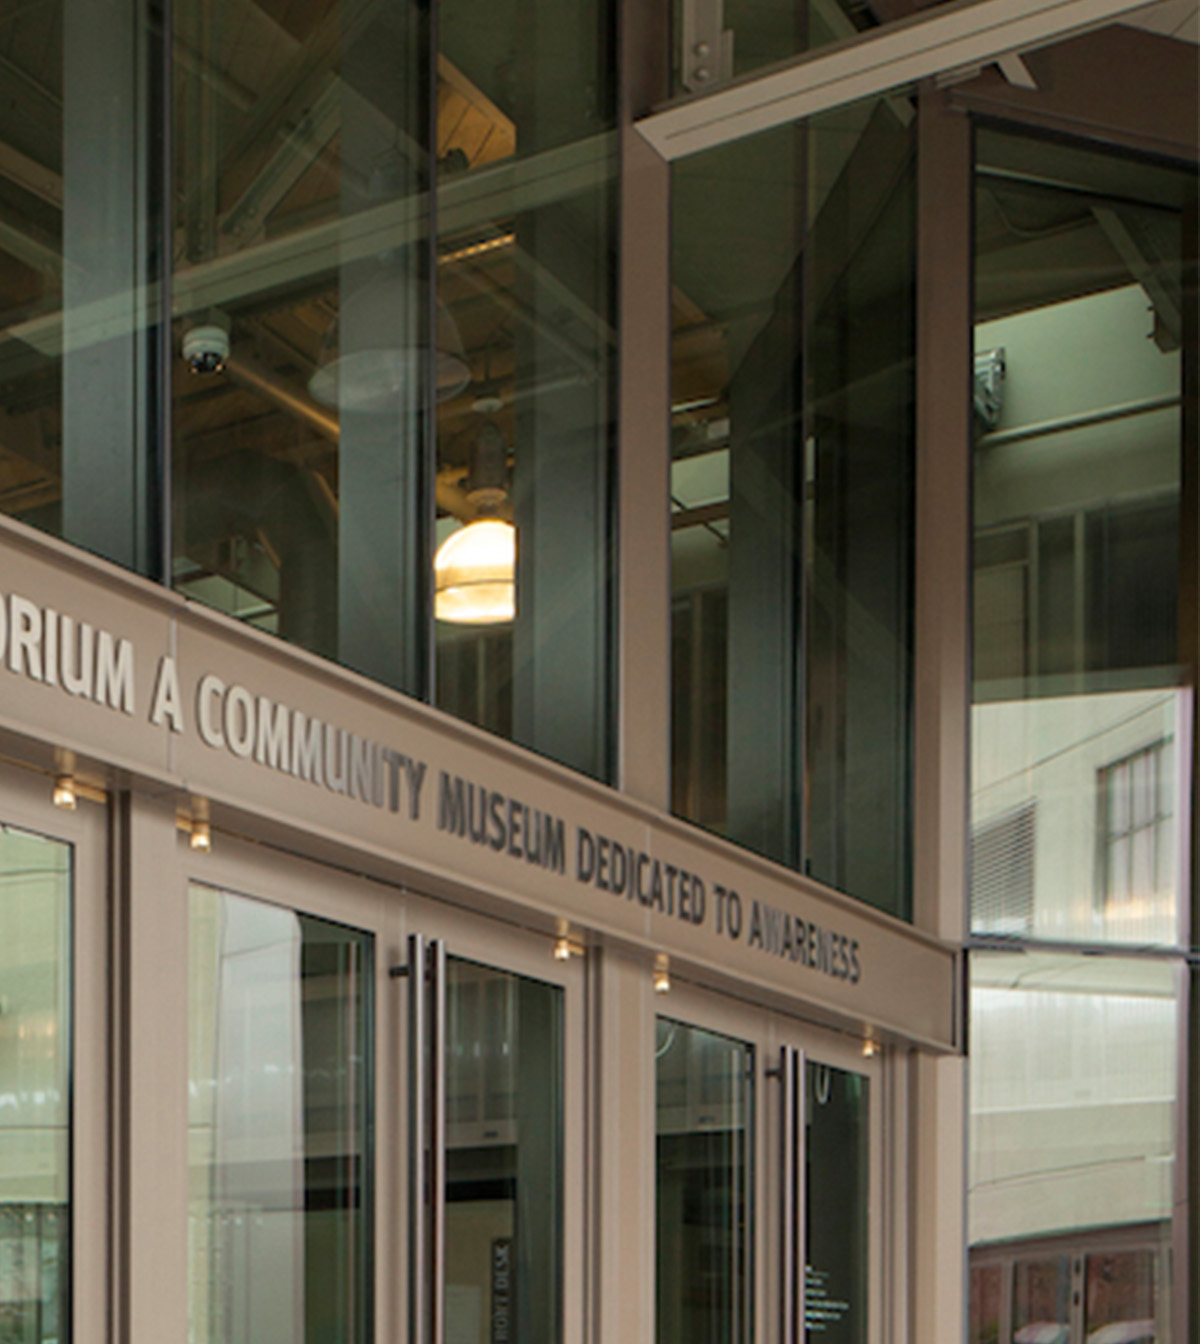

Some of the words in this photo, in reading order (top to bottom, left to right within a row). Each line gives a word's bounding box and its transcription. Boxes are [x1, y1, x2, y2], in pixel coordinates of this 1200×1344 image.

[151, 656, 184, 733] A
[196, 674, 426, 821] COMMUNITY
[437, 770, 565, 875] MUSEUM
[576, 826, 706, 926] DEDICATED
[712, 883, 742, 940] TO
[747, 900, 861, 984] AWARENESS
